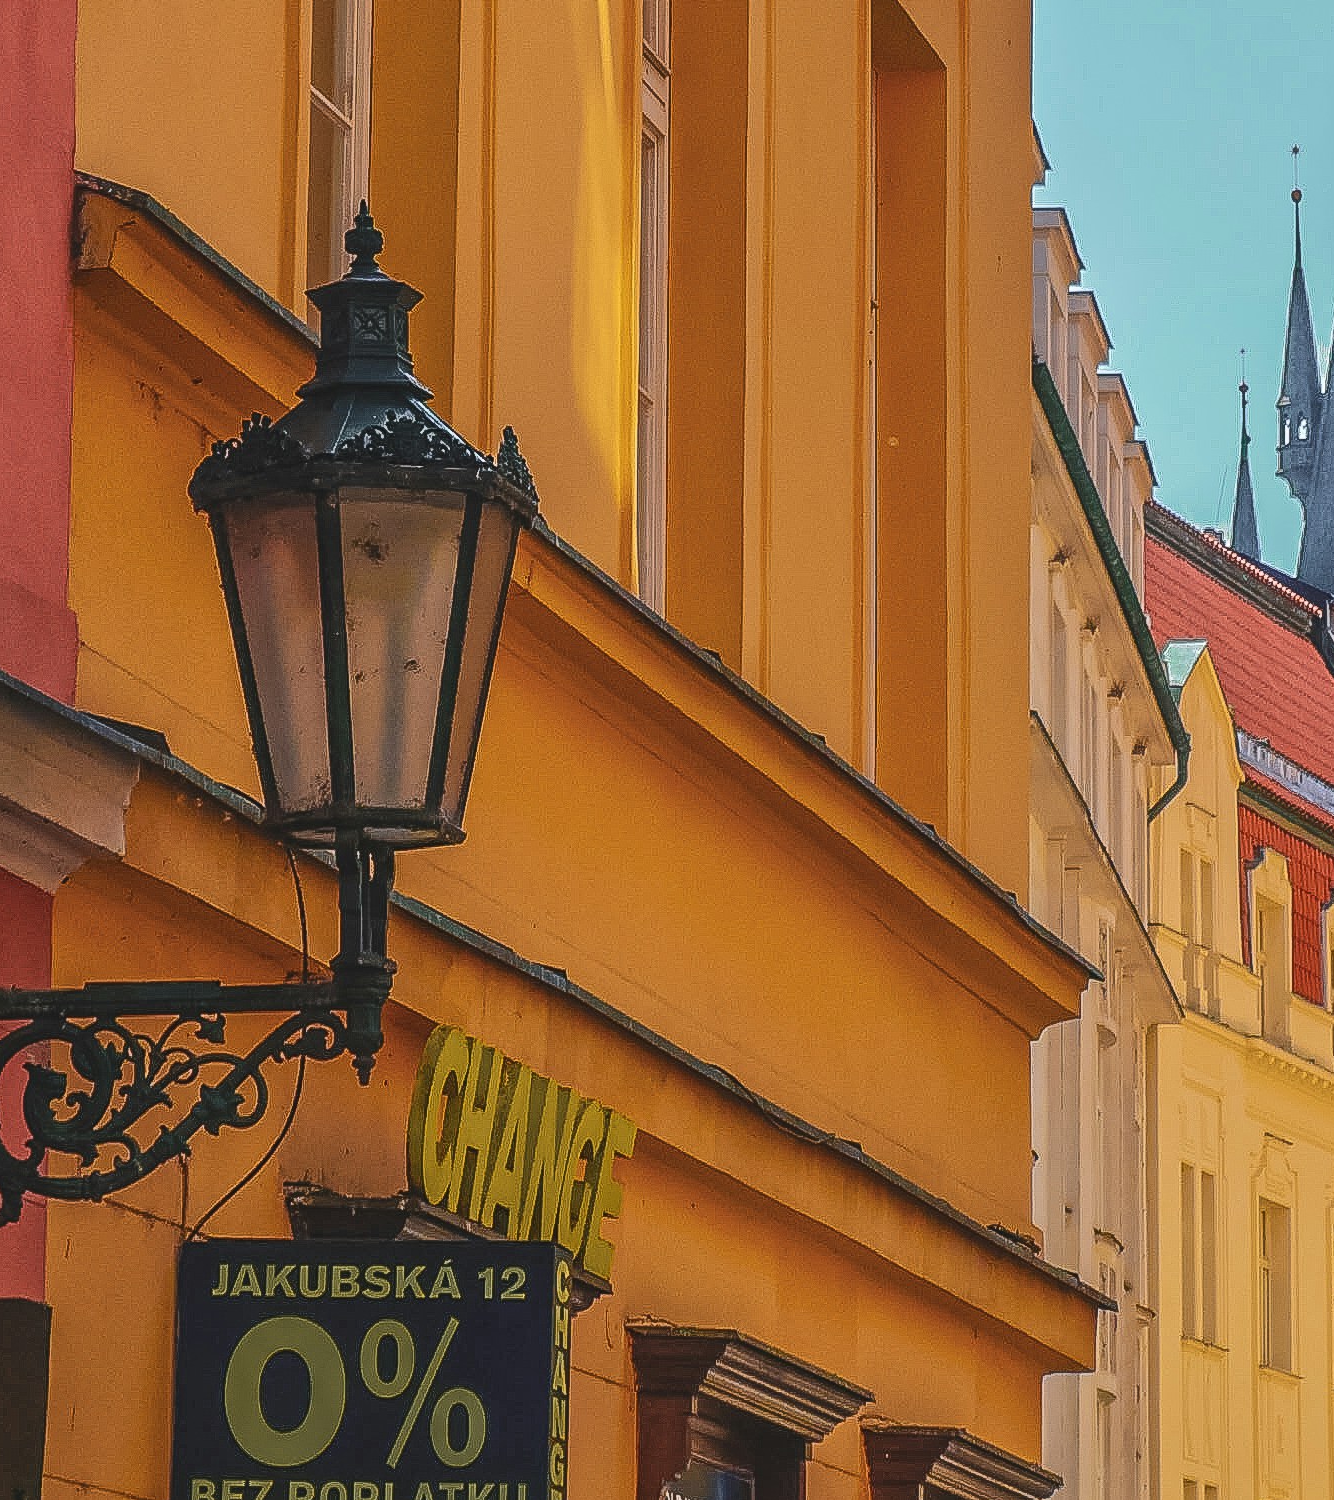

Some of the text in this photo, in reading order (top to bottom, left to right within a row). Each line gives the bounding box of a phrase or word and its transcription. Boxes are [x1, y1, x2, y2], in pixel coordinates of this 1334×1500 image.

[411, 1024, 638, 1281] CHANGE
[211, 1259, 527, 1300] JAKUBSKÁ 12
[224, 1313, 487, 1470] 0%
